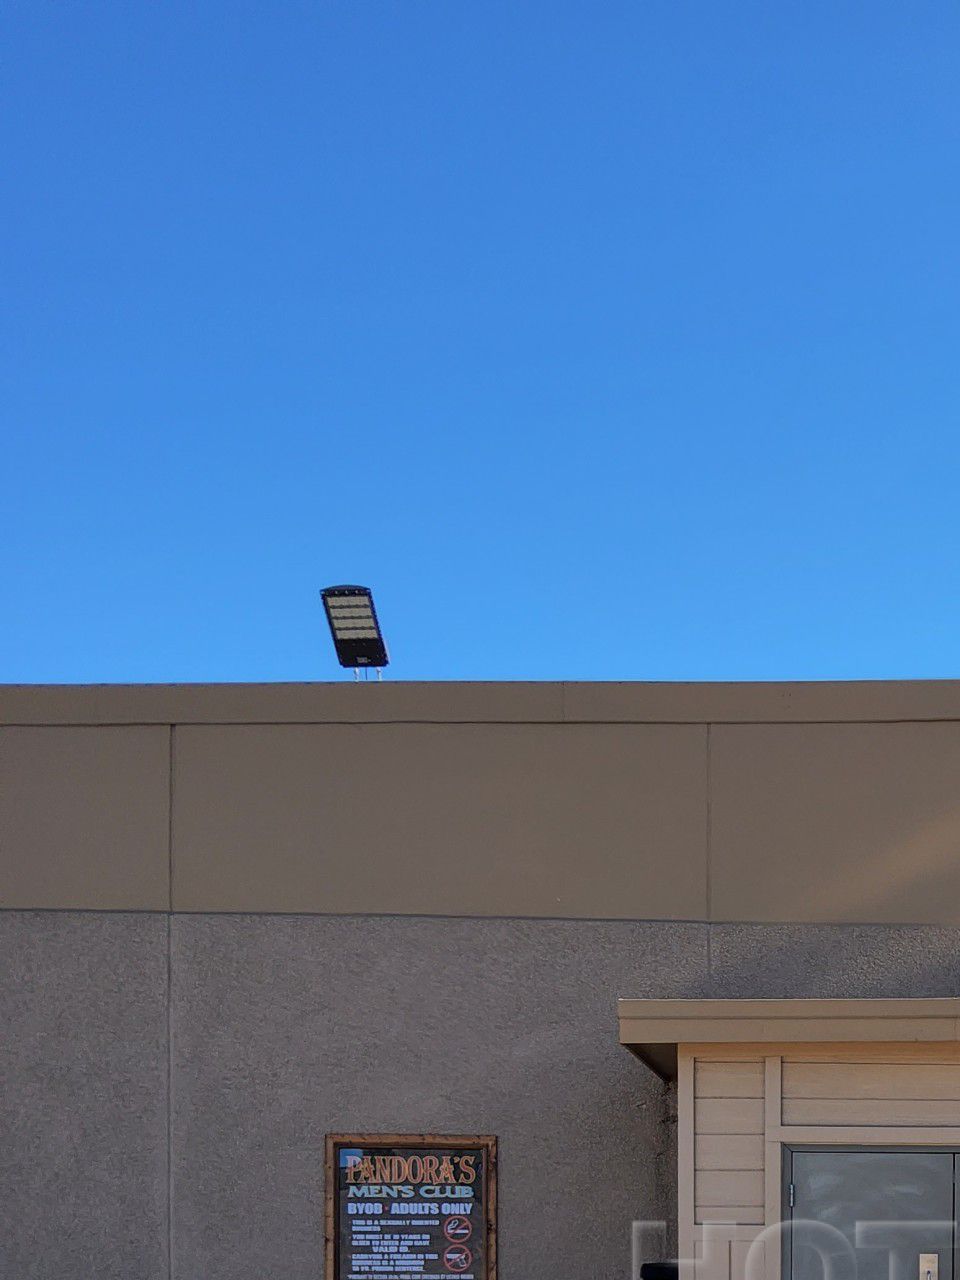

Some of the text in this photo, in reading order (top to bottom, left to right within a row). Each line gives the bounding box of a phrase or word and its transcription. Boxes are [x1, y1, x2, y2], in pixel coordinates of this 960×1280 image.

[345, 1156, 476, 1185] PANDORA'S
[419, 1185, 474, 1198] CLUB
[347, 1203, 473, 1214] BYOB ADULTS ONLY
